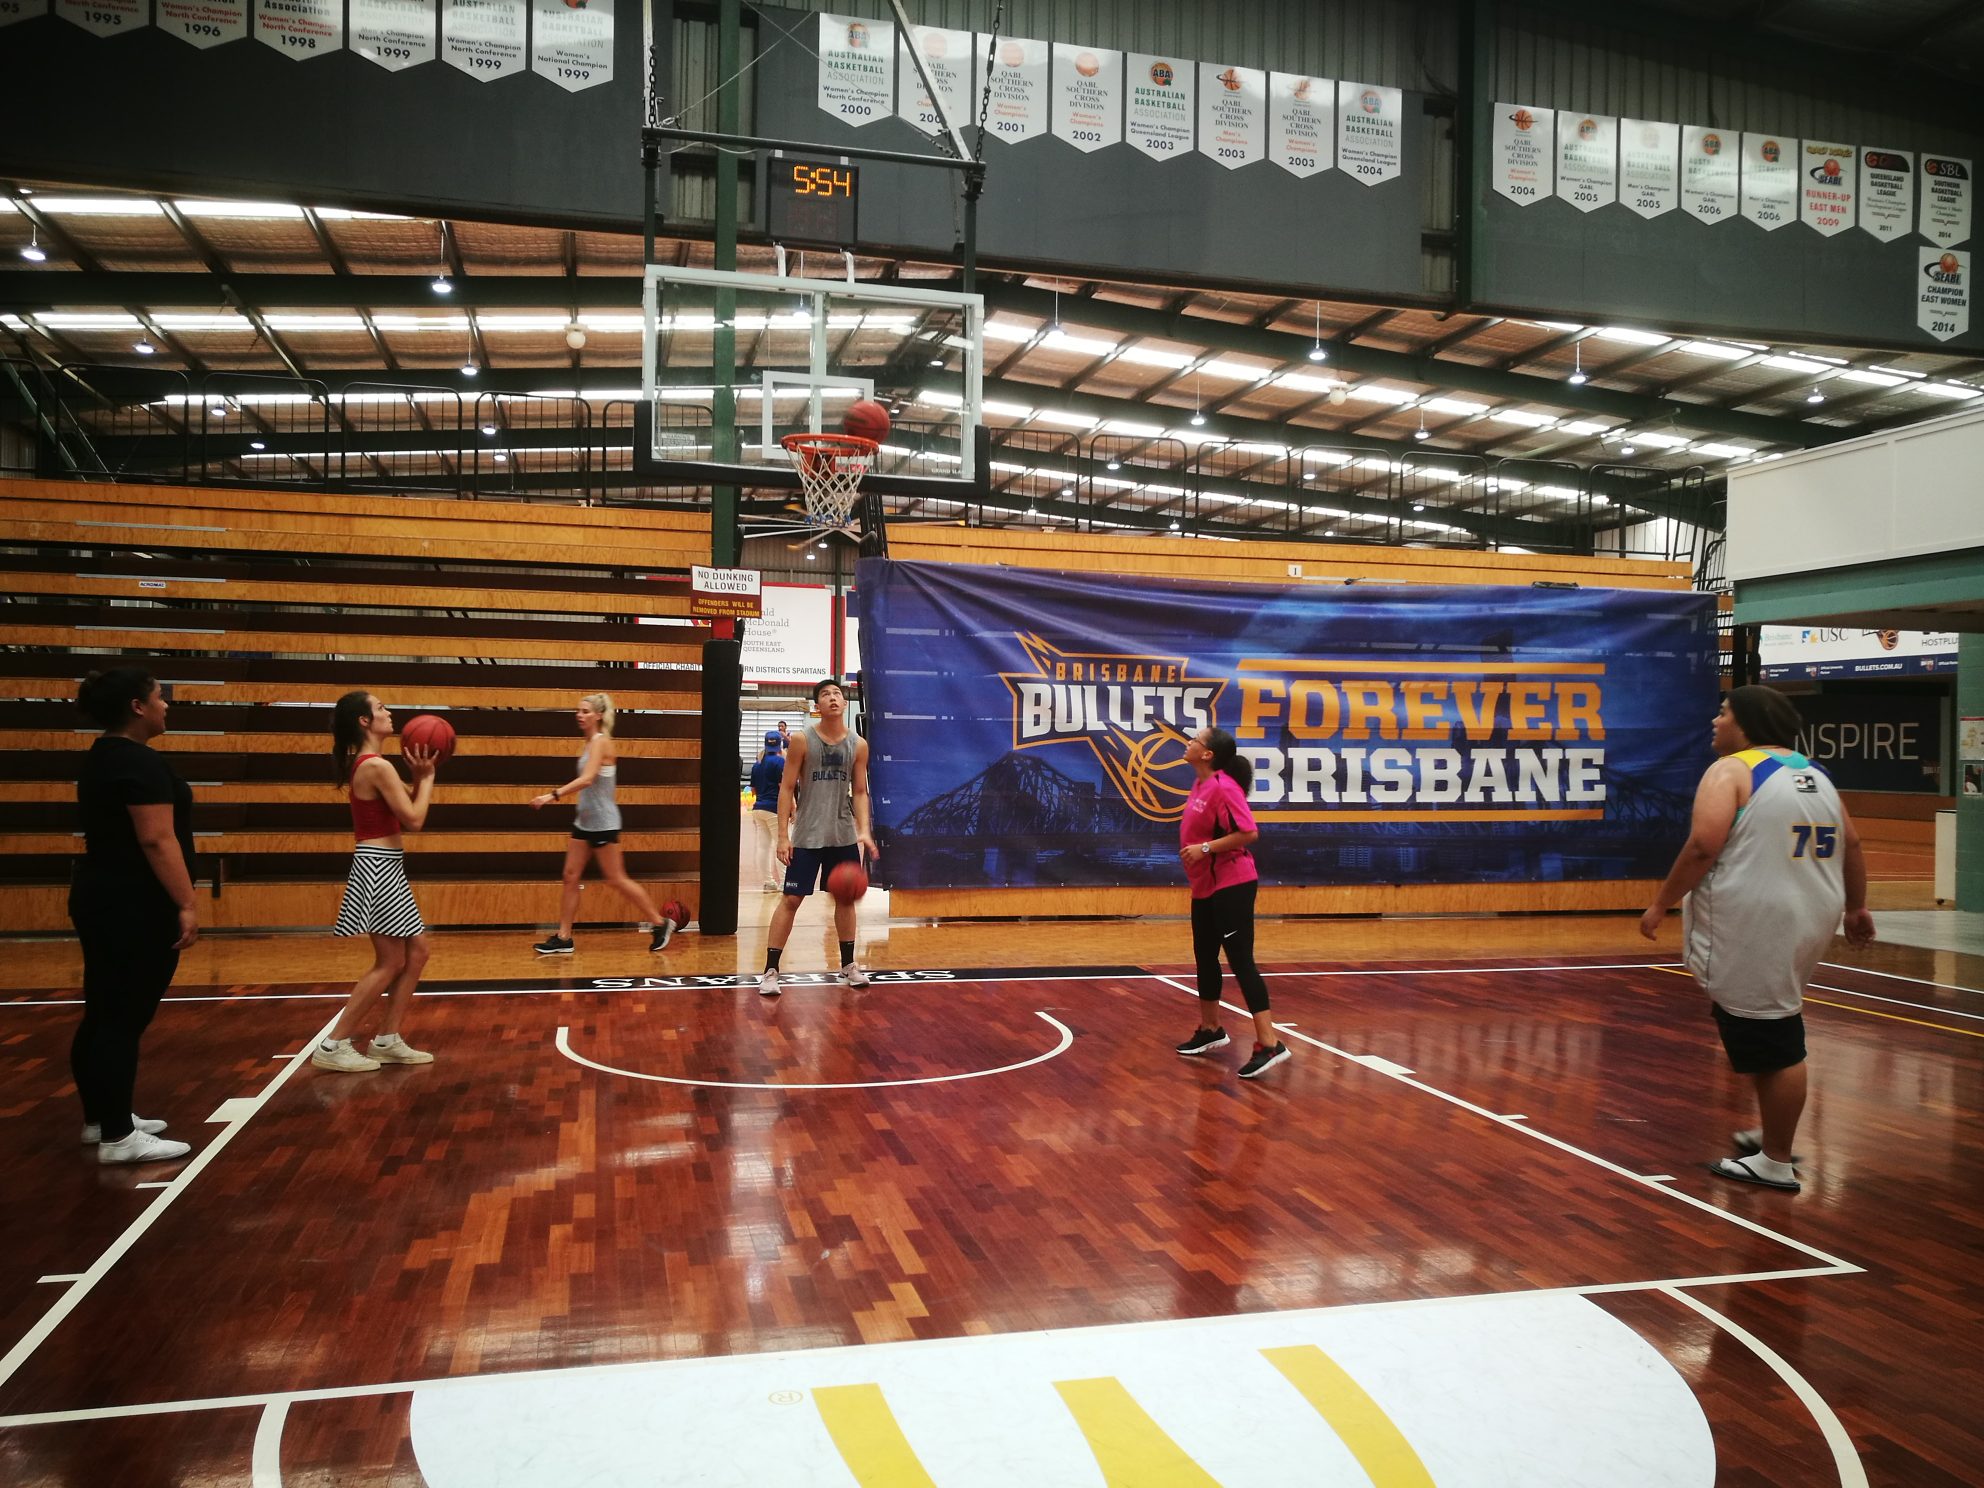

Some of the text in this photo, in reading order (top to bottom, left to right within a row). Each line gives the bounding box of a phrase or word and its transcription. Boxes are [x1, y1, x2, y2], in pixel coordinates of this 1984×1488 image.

[0, 3, 20, 13] 95
[202, 6, 242, 18] Champion
[84, 10, 122, 25] 1995
[166, 10, 238, 25] North Conference
[184, 23, 221, 37] 1996
[262, 22, 333, 38] North Conference
[280, 35, 316, 49] 1998
[358, 34, 426, 48] North Conference
[447, 36, 522, 52] Women's Champion
[376, 46, 411, 60] 1999
[451, 45, 518, 60] North Conference
[555, 50, 590, 60] Women's
[828, 51, 885, 63] AUSTRALIAN
[468, 57, 502, 70] 1999
[537, 55, 608, 70] National Champion
[828, 61, 885, 75] BASKETBALL
[558, 67, 590, 80] 1999
[827, 72, 885, 86] ASSOCIATION
[1153, 69, 1171, 79] ABA
[990, 77, 1034, 88] SOUTHERN
[823, 85, 889, 99] Women's Champion
[999, 85, 1025, 94] CROSS
[1066, 86, 1109, 97] SOUTHERN
[1135, 87, 1187, 101] AUSTRALIAN
[826, 93, 847, 101] North
[994, 91, 1030, 102] DIVISION
[1074, 94, 1101, 103] CROSS
[840, 104, 872, 116] 2000
[1069, 101, 1105, 111] DIVISION
[1134, 98, 1187, 112] BASKETBALL
[1211, 105, 1253, 116] SOUTHERN
[919, 113, 942, 124] 200
[1134, 108, 1187, 122] ASSOCIATION
[1219, 113, 1245, 122] CROSS
[1281, 114, 1322, 125] SOUTHERN
[1345, 114, 1394, 128] AUSTRALIAN
[997, 121, 1026, 133] 2001
[1130, 121, 1191, 135] Women's Champion
[1215, 120, 1250, 129] DIVISION
[1289, 122, 1314, 131] CROSS
[1072, 130, 1102, 142] 2002
[1285, 128, 1319, 139] DIVISION
[1345, 124, 1394, 138] BASKETBALL
[1146, 139, 1175, 151] 2003
[1345, 134, 1394, 148] ASSOCIATION
[1217, 147, 1246, 160] 2003
[1341, 147, 1369, 156] Women's
[1287, 156, 1316, 168] 2003
[1507, 158, 1539, 168] DIVISION
[1356, 165, 1384, 177] 2004
[1939, 162, 1962, 177] SBL
[793, 165, 852, 198] 5:54
[1510, 185, 1536, 197] 2004
[1574, 191, 1599, 203] 2005
[1806, 188, 1852, 203] RUNNER-UP
[1636, 198, 1661, 210] 2005
[1697, 204, 1722, 216] 2006
[1809, 202, 1848, 215] EAST MEN
[1757, 211, 1781, 222] 2006
[1816, 217, 1840, 227] 2009
[1926, 285, 1964, 297] CHAMPION
[1921, 295, 1967, 307] EAST WOMEN
[1931, 321, 1956, 333] 2014
[697, 570, 754, 583] NO DUNKING
[704, 581, 748, 592] ALLOWED
[697, 598, 729, 608] OFFENDERS
[732, 600, 746, 608] WILL
[692, 606, 718, 615] REMOVED
[718, 608, 736, 616] FROM
[736, 609, 761, 617] STADIUM
[743, 618, 790, 628] McDonald
[1820, 627, 1848, 643] USC
[743, 640, 764, 648] SOUTH
[743, 646, 785, 654] QUEENSLAND
[755, 666, 792, 675] DISTRICTS
[792, 667, 828, 676] SPARTANS
[1054, 662, 1179, 683] BRISBANE
[1855, 663, 1903, 672] BULLETS.COM.AU
[1016, 681, 1214, 740] BULLETS
[1233, 677, 1607, 741] FOREVER
[1793, 722, 1920, 761] NSPIRE
[812, 770, 848, 782] BULLETS
[1236, 746, 1607, 803] BRISBANE
[1791, 823, 1838, 860] 75
